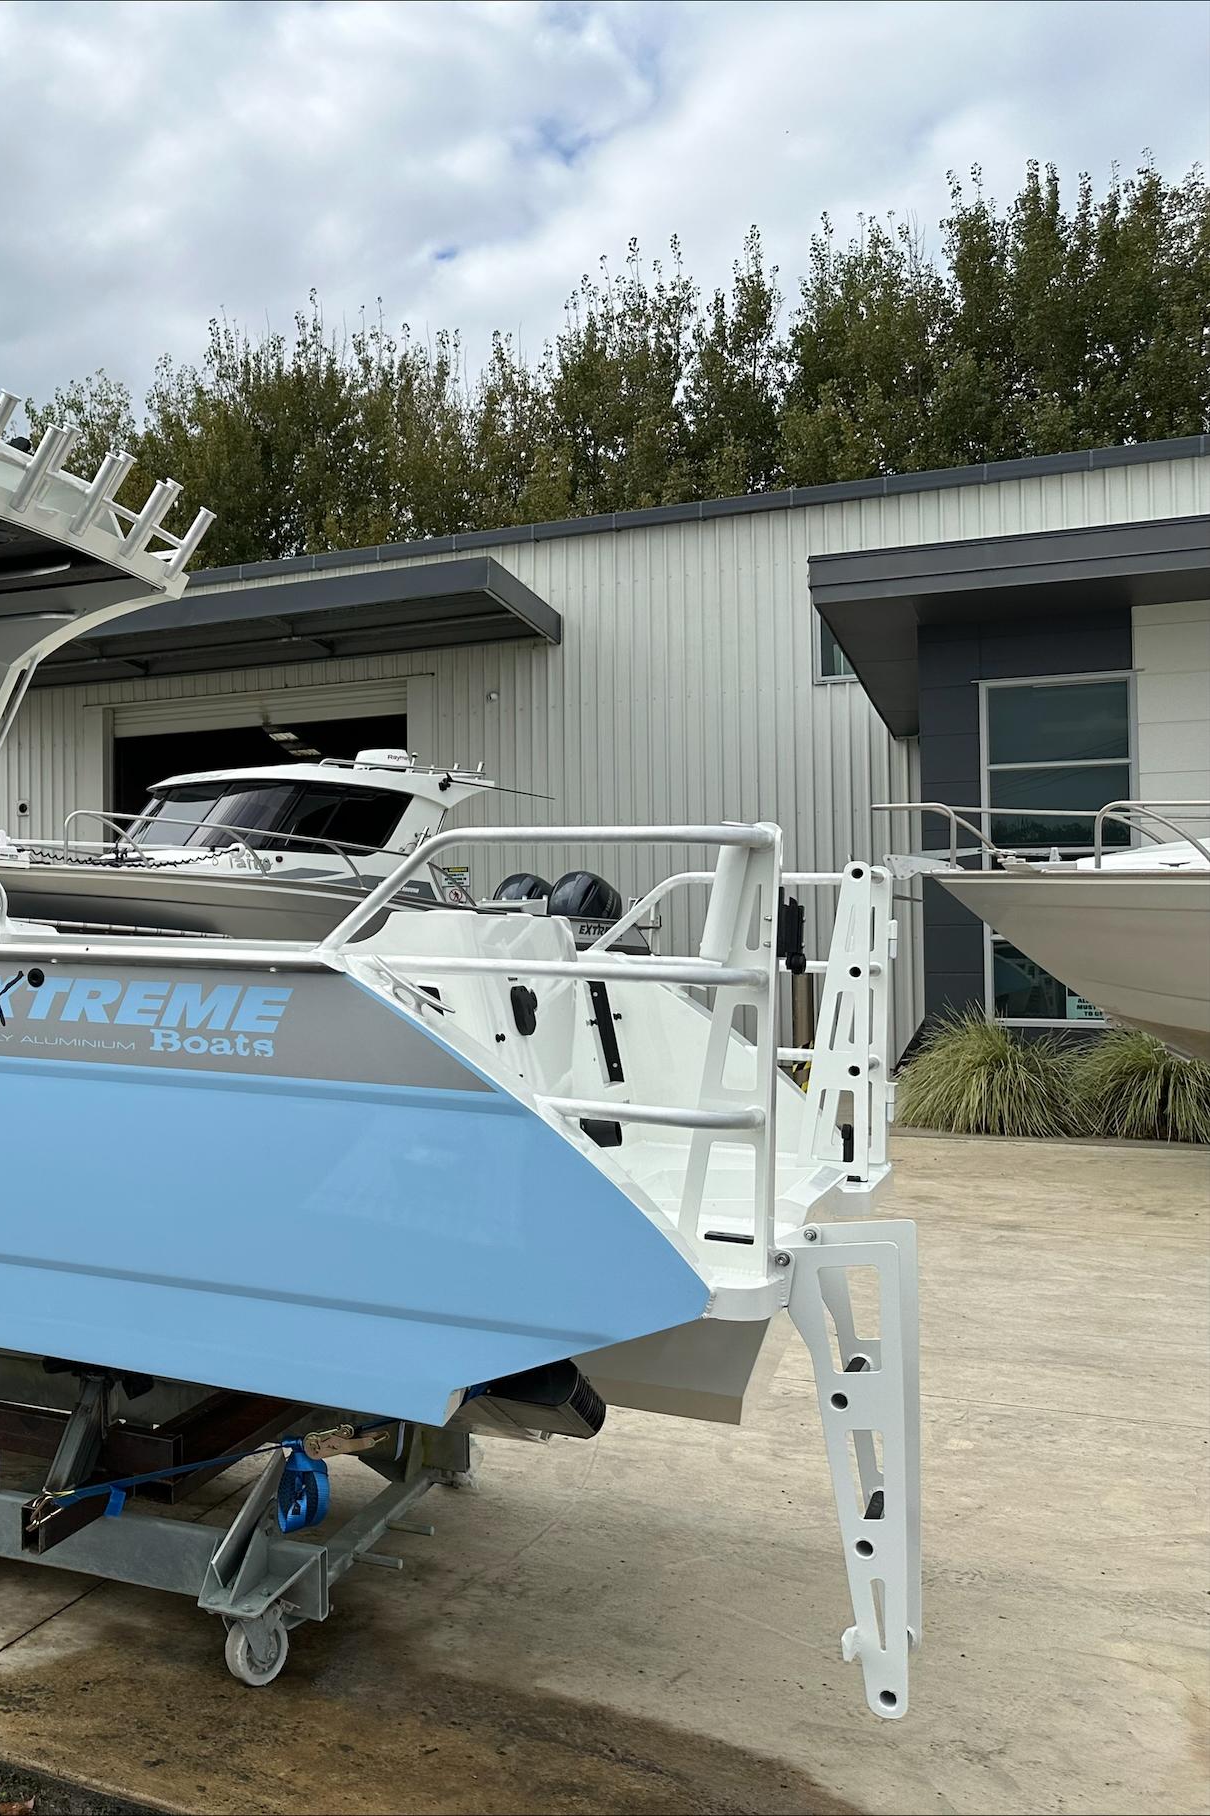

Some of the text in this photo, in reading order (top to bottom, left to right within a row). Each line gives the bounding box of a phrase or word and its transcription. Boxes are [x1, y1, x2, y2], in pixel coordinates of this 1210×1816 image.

[579, 921, 622, 937] EXTR
[20, 1035, 136, 1050] ALUMINIUM
[150, 1029, 274, 1057] Boats
